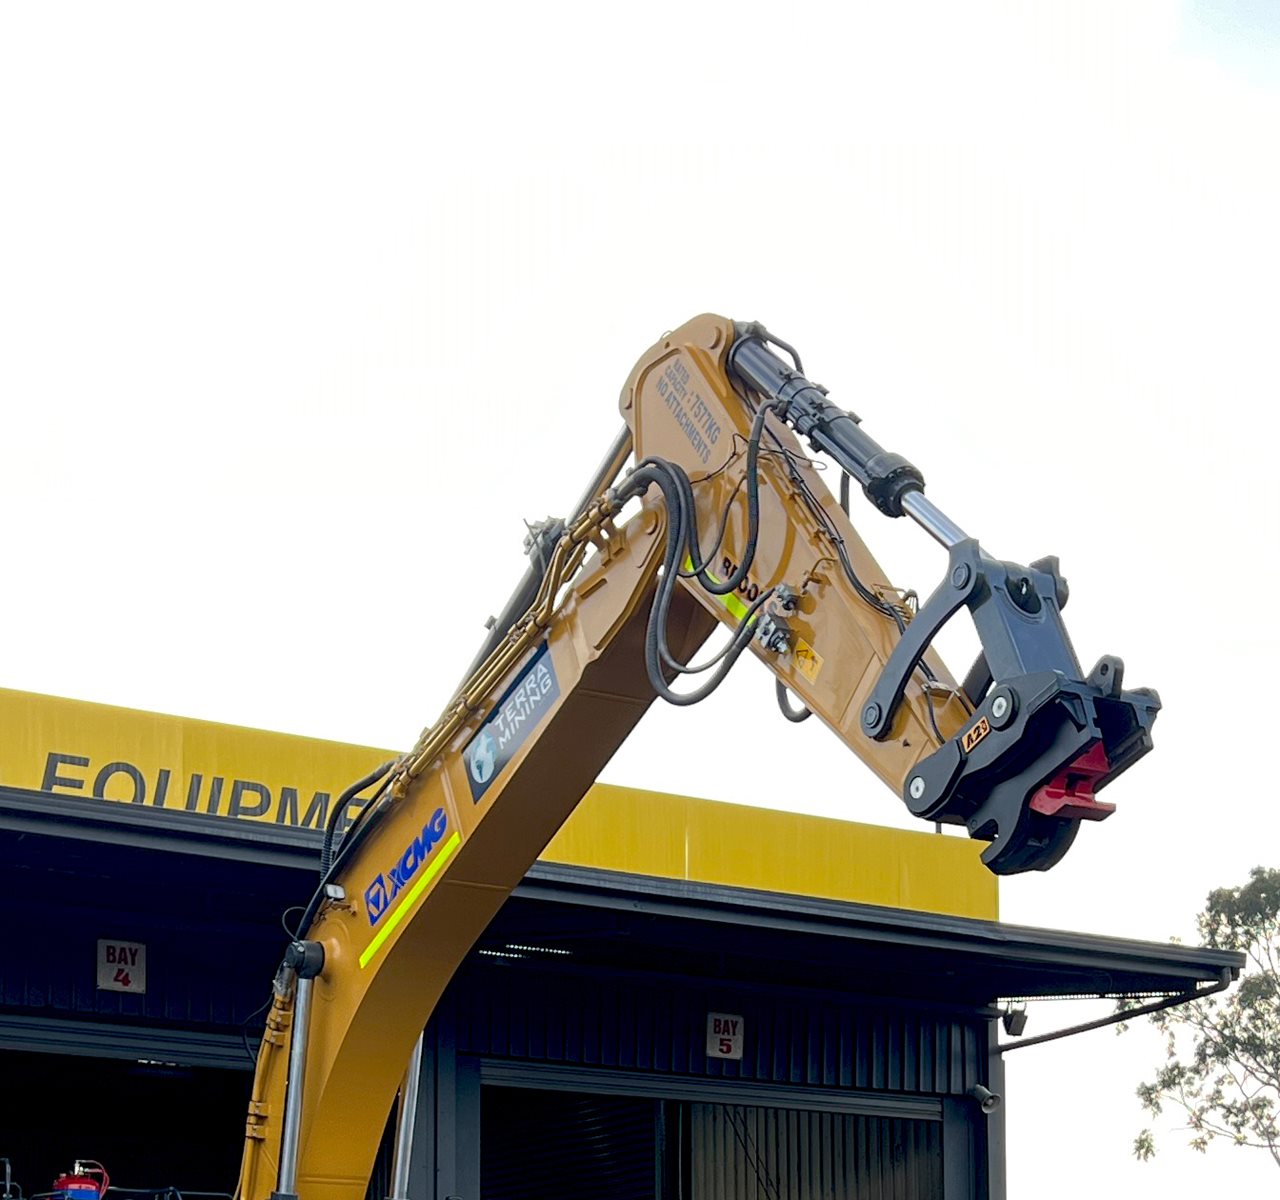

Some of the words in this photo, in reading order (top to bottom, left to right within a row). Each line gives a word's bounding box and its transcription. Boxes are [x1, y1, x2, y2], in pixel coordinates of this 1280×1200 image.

[665, 391, 711, 464] ATTACHMENTS
[495, 663, 549, 732] TERRA
[499, 675, 553, 749] MINING
[388, 807, 447, 900] XCMG
[106, 945, 138, 966] BAY
[113, 968, 132, 987] 4
[713, 1018, 738, 1036] BAY
[718, 1037, 733, 1055] 5
